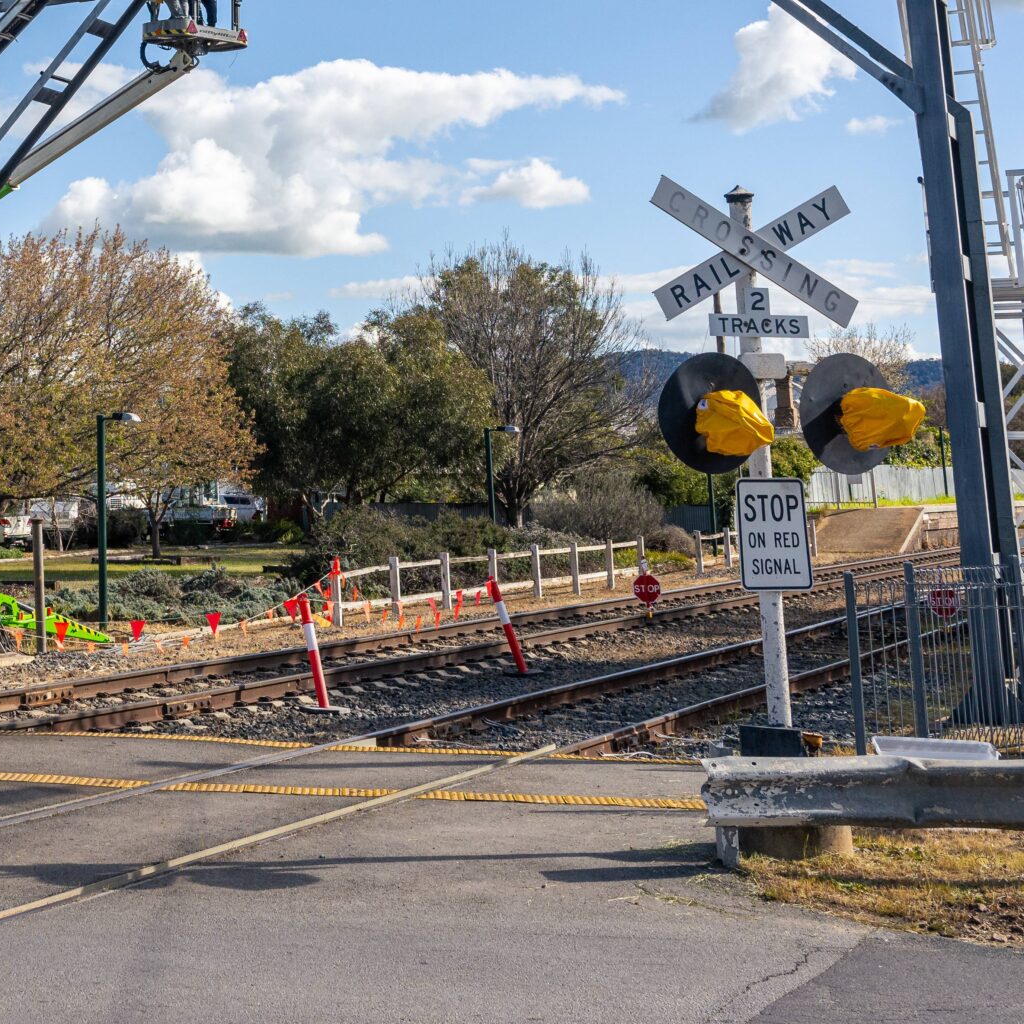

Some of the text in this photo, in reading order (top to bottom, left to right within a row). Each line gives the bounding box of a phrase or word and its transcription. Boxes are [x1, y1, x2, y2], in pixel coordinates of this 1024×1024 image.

[668, 190, 841, 313] CROSSING
[750, 291, 766, 311] 2
[717, 317, 802, 335] TRACKS
[743, 494, 799, 522] STOP
[748, 532, 800, 549] ON RED
[751, 558, 801, 575] SIGNAL
[634, 584, 660, 593] STOP
